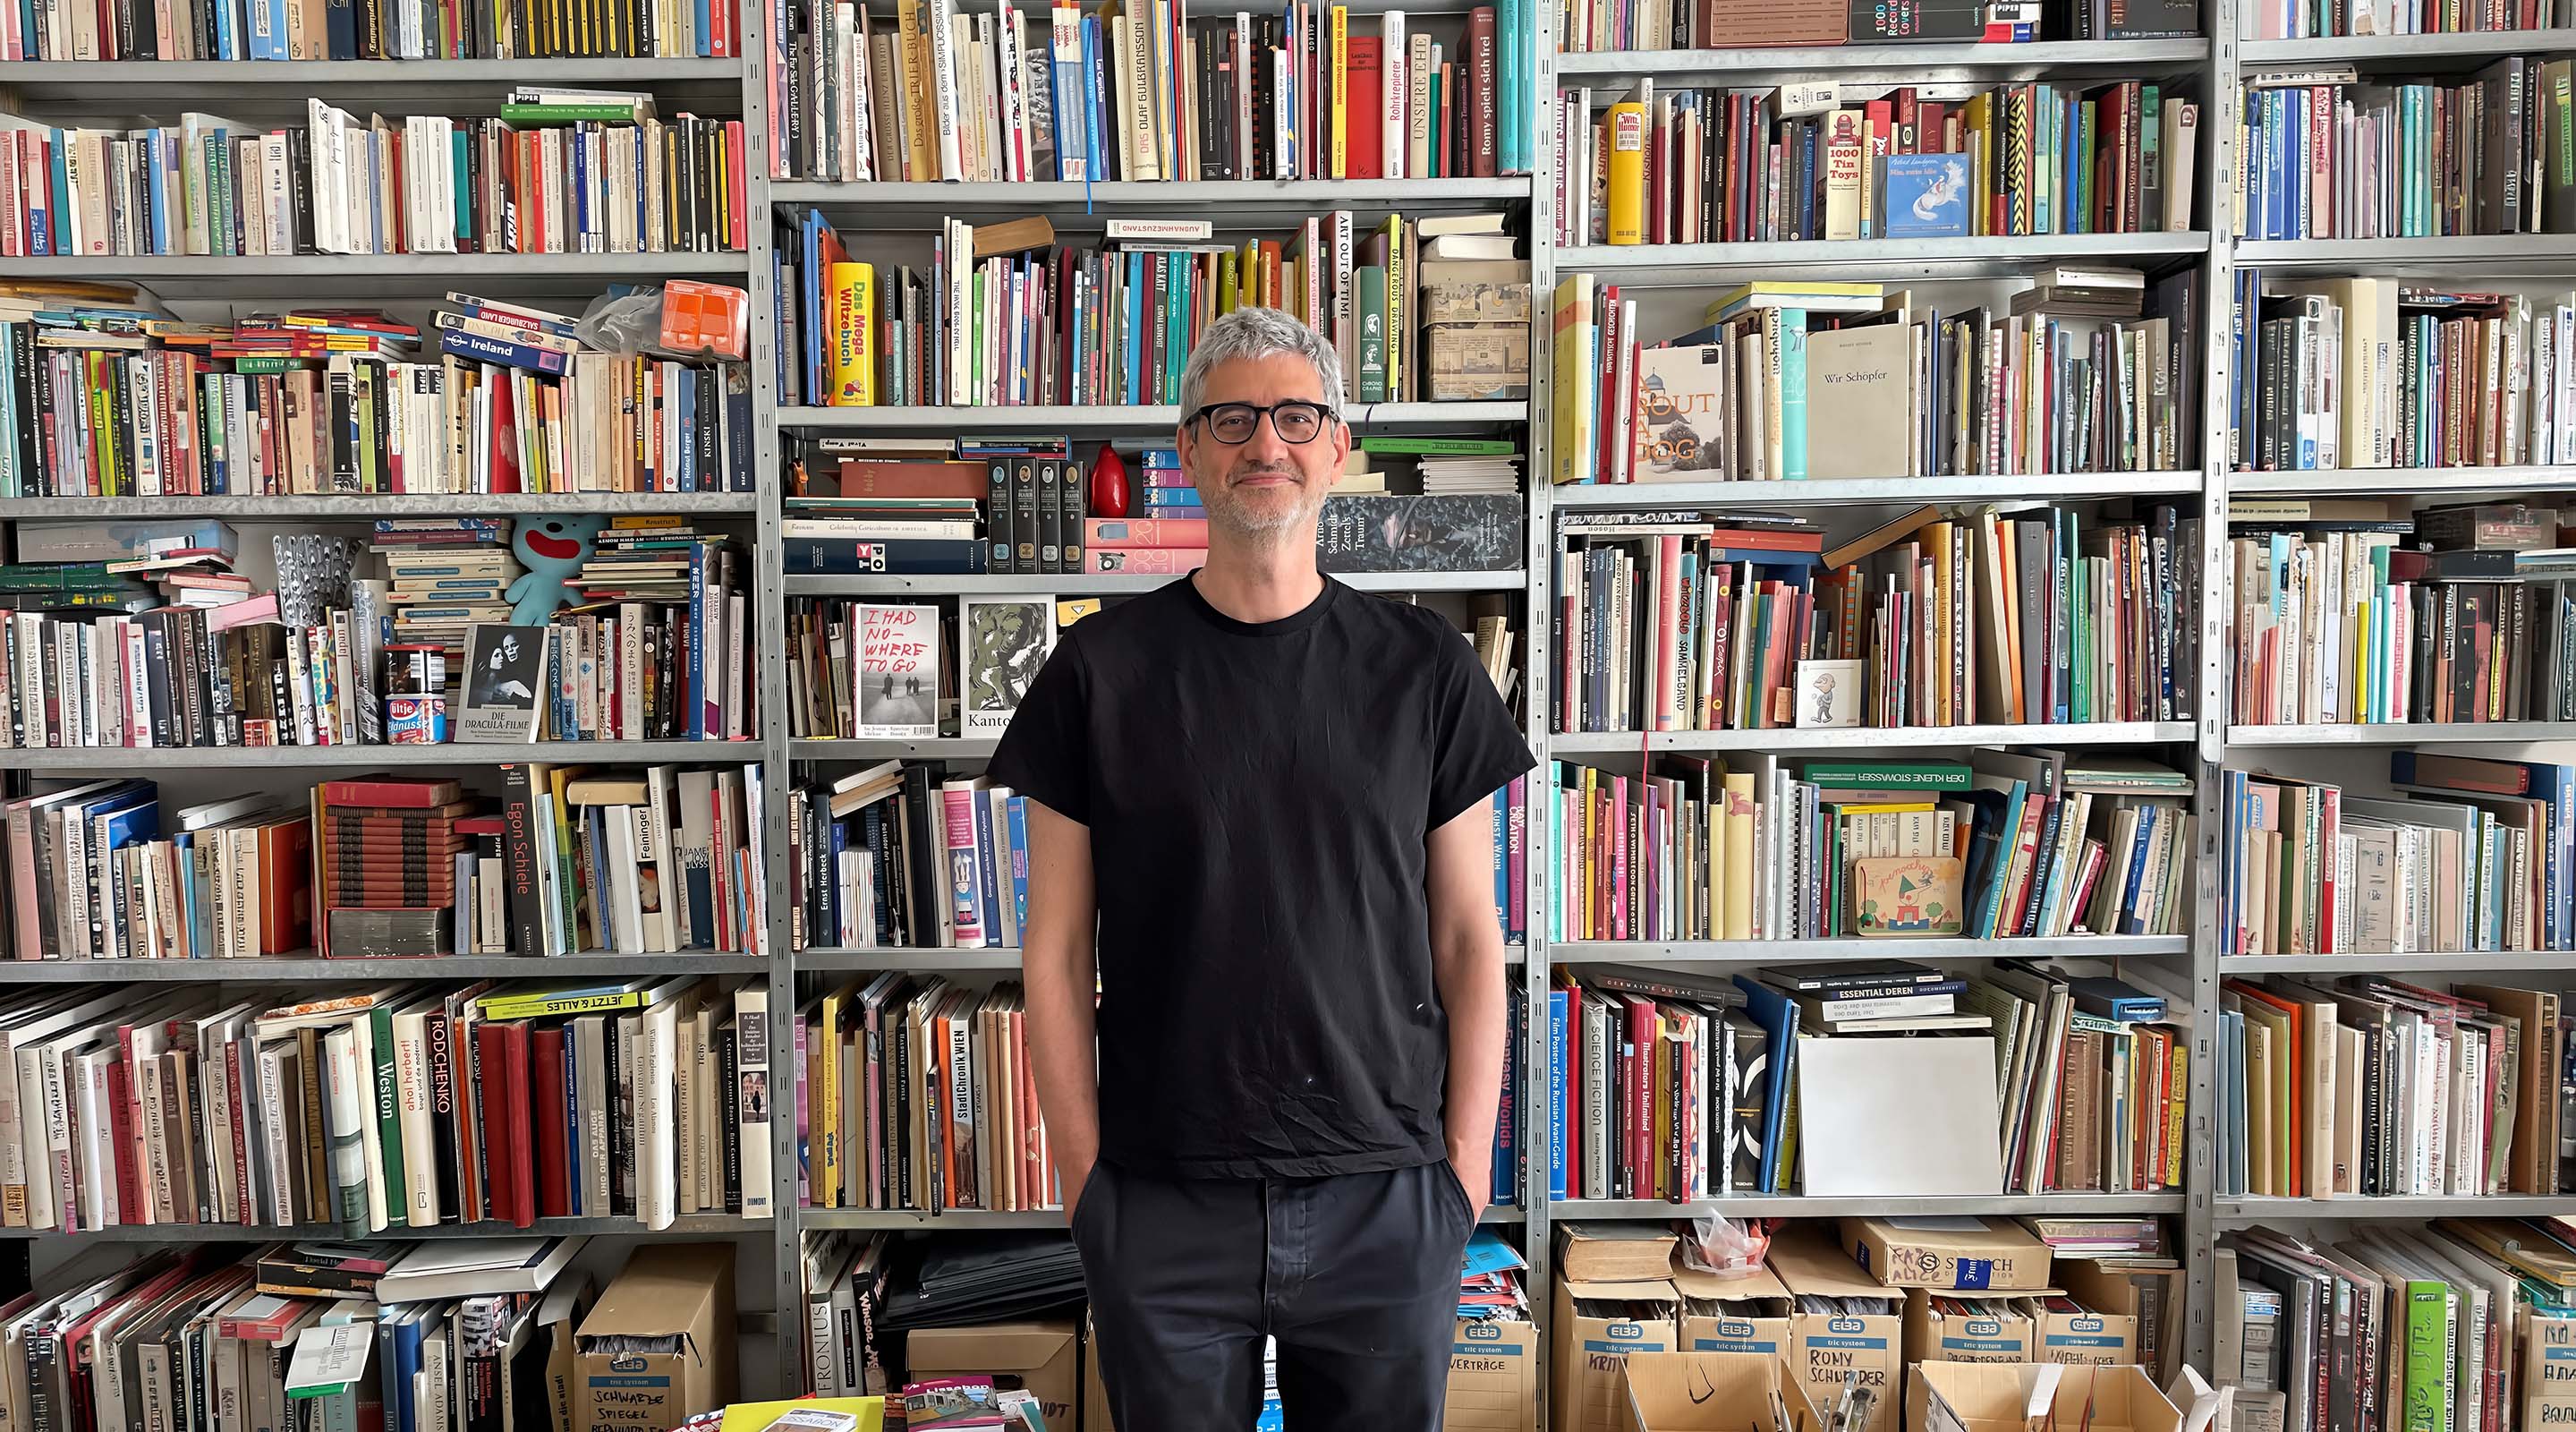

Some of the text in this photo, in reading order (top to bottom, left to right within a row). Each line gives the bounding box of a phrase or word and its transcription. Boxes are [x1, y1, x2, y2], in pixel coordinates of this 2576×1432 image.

[788, 5, 797, 30] Larson
[1875, 4, 1887, 32] 1000
[1887, 0, 1899, 36] Record
[1899, 0, 1910, 36] Covers
[1996, 4, 2019, 12] PIPER
[789, 42, 798, 56] The
[790, 57, 798, 70] Far
[905, 11, 923, 147] Das große TRIER-BUCH
[1135, 21, 1150, 154] DAS OLAF GULBRANSSON
[1389, 60, 1402, 121] Rohrkrepierer
[1414, 38, 1427, 141] UNSERE EHE
[516, 93, 540, 103] PIPER
[939, 73, 951, 135] Bilder aus dem
[1479, 36, 1493, 156] Romy spielt sich frei
[887, 145, 895, 161] DER
[1597, 126, 1608, 175] PEANUTS
[1641, 144, 1652, 182] Kishon
[1830, 149, 1858, 158] 1000
[1833, 159, 1853, 168] Tin
[1828, 168, 1858, 181] Toys
[1156, 256, 1168, 292] KLAS KATT
[1339, 216, 1349, 320] ART OUT OF TIME
[1390, 249, 1399, 354] DANGEROUS DRAWINGS
[480, 310, 539, 330] SALZBURGER LAND
[840, 287, 853, 367] Witzebuch
[853, 281, 866, 355] Das Mega
[471, 337, 514, 357] Ireland
[1824, 370, 1888, 384] Wir Schöpfer
[684, 432, 692, 455] Berger
[703, 426, 711, 457] KINSKI
[684, 455, 692, 479] Helmut
[1135, 520, 1153, 545] 20
[1316, 514, 1338, 555] Arno Schmidt
[1355, 516, 1365, 551] Traum
[863, 609, 917, 625] I HAD
[336, 629, 349, 659] Japan
[625, 611, 636, 669] うみべのまち
[864, 643, 929, 657] WHERE
[1676, 576, 1694, 711] WITZBOLD SAMMELBAND
[863, 658, 917, 673] TO GO
[391, 703, 412, 715] ültje
[491, 712, 506, 721] DIE
[464, 720, 530, 730] DRACULA-FILME
[1858, 772, 1965, 782] DER KLEINE STOWASSER
[638, 809, 650, 859] Feininger
[1492, 809, 1503, 870] KUNST WAHN
[1509, 806, 1519, 855] CREATION
[507, 802, 531, 895] Egon Schiele
[586, 871, 595, 891] Katja
[818, 854, 829, 910] Ernst Herbeck
[1607, 979, 1692, 996] GERMAINE DULAC
[1839, 986, 1913, 998] ESSENTIAL DEREN
[547, 995, 624, 1012] JETZT & ALLES
[953, 1030, 965, 1055] WIEN
[1591, 1025, 1602, 1076] SCIENCE
[431, 1020, 450, 1112] RODCHENKO
[636, 1054, 645, 1097] Giovanni
[649, 1027, 658, 1134] William Eggleston Los Alamos
[378, 1061, 395, 1120] Weston
[1552, 1018, 1560, 1169] Film Posters of the Russian Avant-Garde
[1642, 1042, 1651, 1131] Illustrators Unlimited
[887, 1029, 897, 1191] INTERNATIONAL POSTER ANNUAL
[1591, 1079, 1602, 1125] FICTION
[1498, 1095, 1514, 1149] Worlds
[591, 1138, 599, 1158] DAS
[597, 1109, 608, 1196] UND DER APPARAT
[747, 1197, 767, 1206] DUMONT
[304, 1256, 328, 1266] David
[1892, 1268, 1943, 1283] ALICE
[859, 1291, 873, 1344] WINSOR
[812, 1306, 832, 1392] FRONIUS
[1477, 1346, 1502, 1355] system
[1809, 1349, 1853, 1368] ROMY
[1841, 1340, 1865, 1349] system
[1977, 1342, 2002, 1351] system
[1450, 1357, 1505, 1371] VERTRÄGE
[433, 1355, 445, 1431] ANSEL ADAMS
[598, 1408, 649, 1419] SPIEGEL
